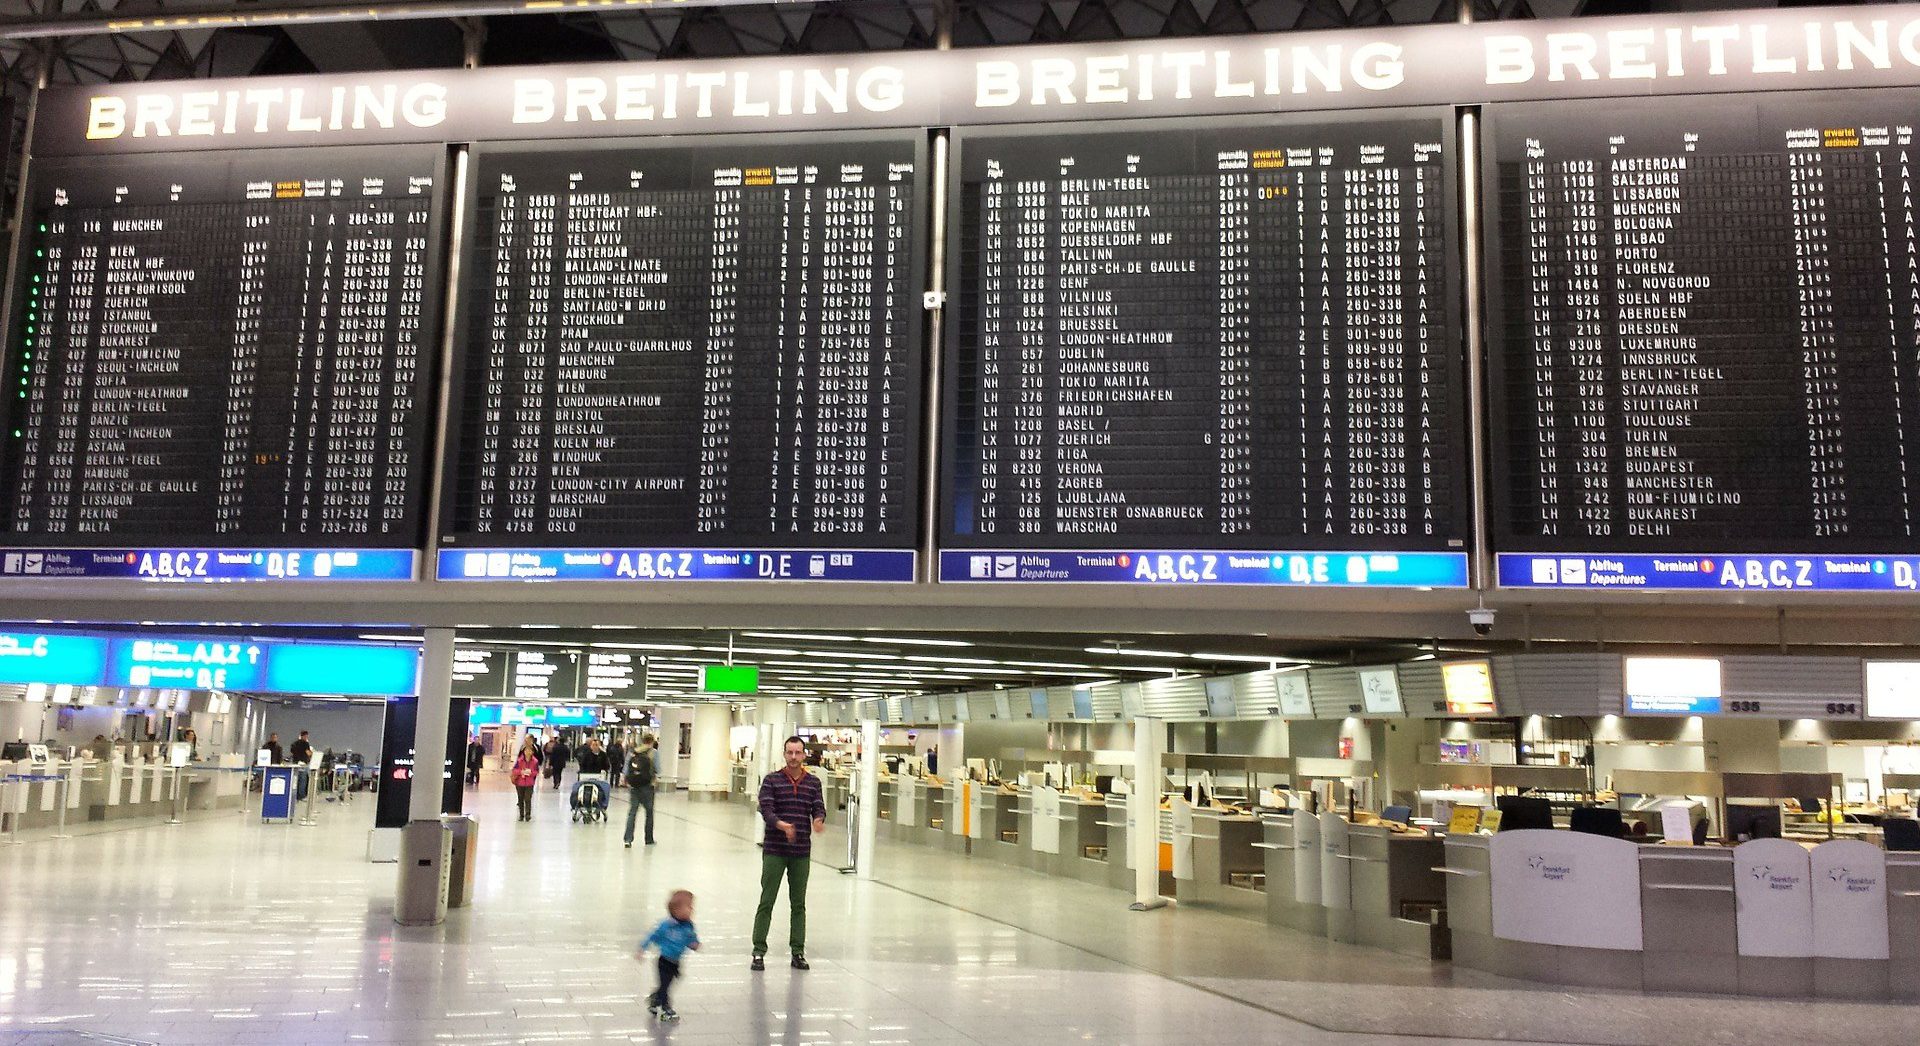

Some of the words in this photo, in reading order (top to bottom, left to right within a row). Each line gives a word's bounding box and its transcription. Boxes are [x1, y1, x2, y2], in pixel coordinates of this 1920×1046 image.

[976, 43, 1404, 107] BREITLING
[512, 65, 905, 123] BREITLING
[85, 82, 447, 139] BREITLING
[1361, 155, 1384, 164] Counter
[1612, 157, 1686, 171] AMSTERDAM
[1613, 172, 1678, 186] SALZBURG
[1062, 178, 1149, 192] BERLIN-TEGEL
[1061, 193, 1089, 205] MALE
[1614, 187, 1679, 200] LISSABON
[570, 194, 609, 206] MADRID
[569, 206, 629, 219] STUTTGART
[1061, 207, 1097, 219] TOKIO
[1106, 205, 1150, 218] NARITA
[1614, 202, 1680, 215] MUENCHEN
[113, 219, 162, 231] MUENCHEN
[568, 220, 621, 232] HELSINKI
[1061, 220, 1135, 233] KOPENHAGEN
[1615, 217, 1673, 230] BOLOGNA
[568, 234, 586, 245] TEL
[594, 233, 621, 244] AVIV
[1061, 234, 1141, 247] DUESSELDORF
[1151, 233, 1172, 244] HBF
[1615, 232, 1664, 245] BILBAO
[111, 246, 135, 256] WIEN
[566, 246, 627, 258] AMSTERDAM
[1061, 248, 1112, 260] TALLINN
[1616, 248, 1657, 259] PORTO
[109, 259, 139, 269] KOELN
[146, 257, 164, 268] HBF
[566, 259, 660, 271] MAILAND-LINATE
[1151, 261, 1195, 272] GAULLE
[1617, 262, 1674, 274] FLORENZ
[107, 270, 194, 282] MOSKAU-VNUKOVO
[565, 273, 667, 285] LONDON-HEATHROW
[1061, 277, 1088, 288] GENF
[1643, 277, 1709, 288] NOVGOROD
[564, 287, 645, 298] BERLIN-TEGEL
[1060, 291, 1111, 302] VILNIUS
[1670, 292, 1692, 303] HBF
[105, 297, 147, 308] ZUERICH
[104, 310, 151, 320] ISTANBUL
[1060, 305, 1117, 316] HELSINKI
[1619, 307, 1686, 319] ABERDEEN
[563, 314, 623, 325] STOCKHOLM
[1060, 319, 1118, 330] BRUESSEL
[102, 323, 157, 334] STOCKHOLM
[1619, 323, 1678, 334] DRESDEN
[100, 336, 148, 346] BUKAREST
[1060, 332, 1172, 344] LONDON-HEATHROW
[99, 349, 180, 359] ROM-FIUMICINO
[1060, 348, 1104, 359] DUBLIN
[1624, 353, 1697, 364] INNSBRUCK
[560, 355, 614, 366] MUENCHEN
[97, 362, 178, 373] SEOUL-INCHEON
[1060, 362, 1149, 373] JOHANNESBURG
[559, 369, 606, 379] HAMBURG
[1622, 368, 1723, 380] BERLIN-TEGEL
[96, 376, 126, 386] SOFIA
[1060, 377, 1095, 387] TOKIO
[1104, 376, 1149, 386] NARITA
[94, 388, 188, 399] LONDON-HEATHROW
[558, 383, 584, 393] WIEN
[1623, 384, 1698, 395] STAVANGER
[1060, 390, 1172, 401] FRIEDRICHSHAFEN
[92, 402, 166, 412] BERLIN-TEGEL
[1059, 405, 1102, 416] MADRID
[1624, 400, 1697, 410] STUTTGART
[91, 415, 128, 425] DANZIG
[556, 410, 602, 420] BRISTOL
[1625, 415, 1691, 426] TOULOUSE
[555, 424, 603, 434] BRESLAU
[1059, 420, 1094, 430] BASEL
[90, 428, 171, 438] SEOUL-INCHEON
[1626, 431, 1667, 441] TURIN
[554, 438, 588, 448] KOELN
[596, 438, 615, 448] HBF
[1058, 434, 1110, 445] ZUERICH
[88, 442, 125, 452] ASTANA
[1626, 446, 1676, 457] BREMEN
[553, 452, 601, 462] WINDHUK
[1058, 449, 1087, 459] RIGA
[87, 455, 161, 465] BERLIN-TEGEL
[552, 466, 579, 476] WIEN
[1058, 463, 1102, 474] VERONA
[1627, 462, 1693, 472] BUDAPEST
[85, 468, 129, 478] HAMBURG
[160, 482, 197, 492] GAULLE
[552, 479, 627, 490] LONDON-CITY
[635, 479, 684, 489] AIRPORT
[1058, 478, 1102, 488] ZAGREB
[1627, 477, 1712, 488] MANCHESTER
[82, 495, 132, 505] LISSABON
[551, 493, 605, 504] WARSCHAU
[1058, 492, 1125, 503] LJUBLJANA
[1628, 493, 1740, 504] ROM-FIUMICINO
[81, 508, 118, 518] PEKING
[549, 507, 581, 518] DUBAI
[1057, 507, 1117, 518] MUENSTER
[1127, 507, 1203, 518] OSNABRUECK
[1629, 508, 1696, 519] BUKAREST
[79, 521, 110, 532] MALTA
[548, 521, 575, 532] OSLO
[1630, 524, 1669, 535] DELHI
[94, 554, 124, 563] Terminal
[703, 554, 739, 565] Terminal
[744, 555, 750, 564] 2
[1021, 556, 1050, 568] Abflug
[1077, 556, 1115, 566] Terminal
[1122, 557, 1126, 566] 1
[1589, 560, 1624, 572] Abflug
[1654, 560, 1698, 572] Terminal
[1825, 561, 1870, 573] Terminal
[1021, 568, 1069, 579] Departures
[1589, 573, 1646, 585] Departures
[1730, 701, 1760, 712] 535
[1826, 703, 1855, 714] 534
